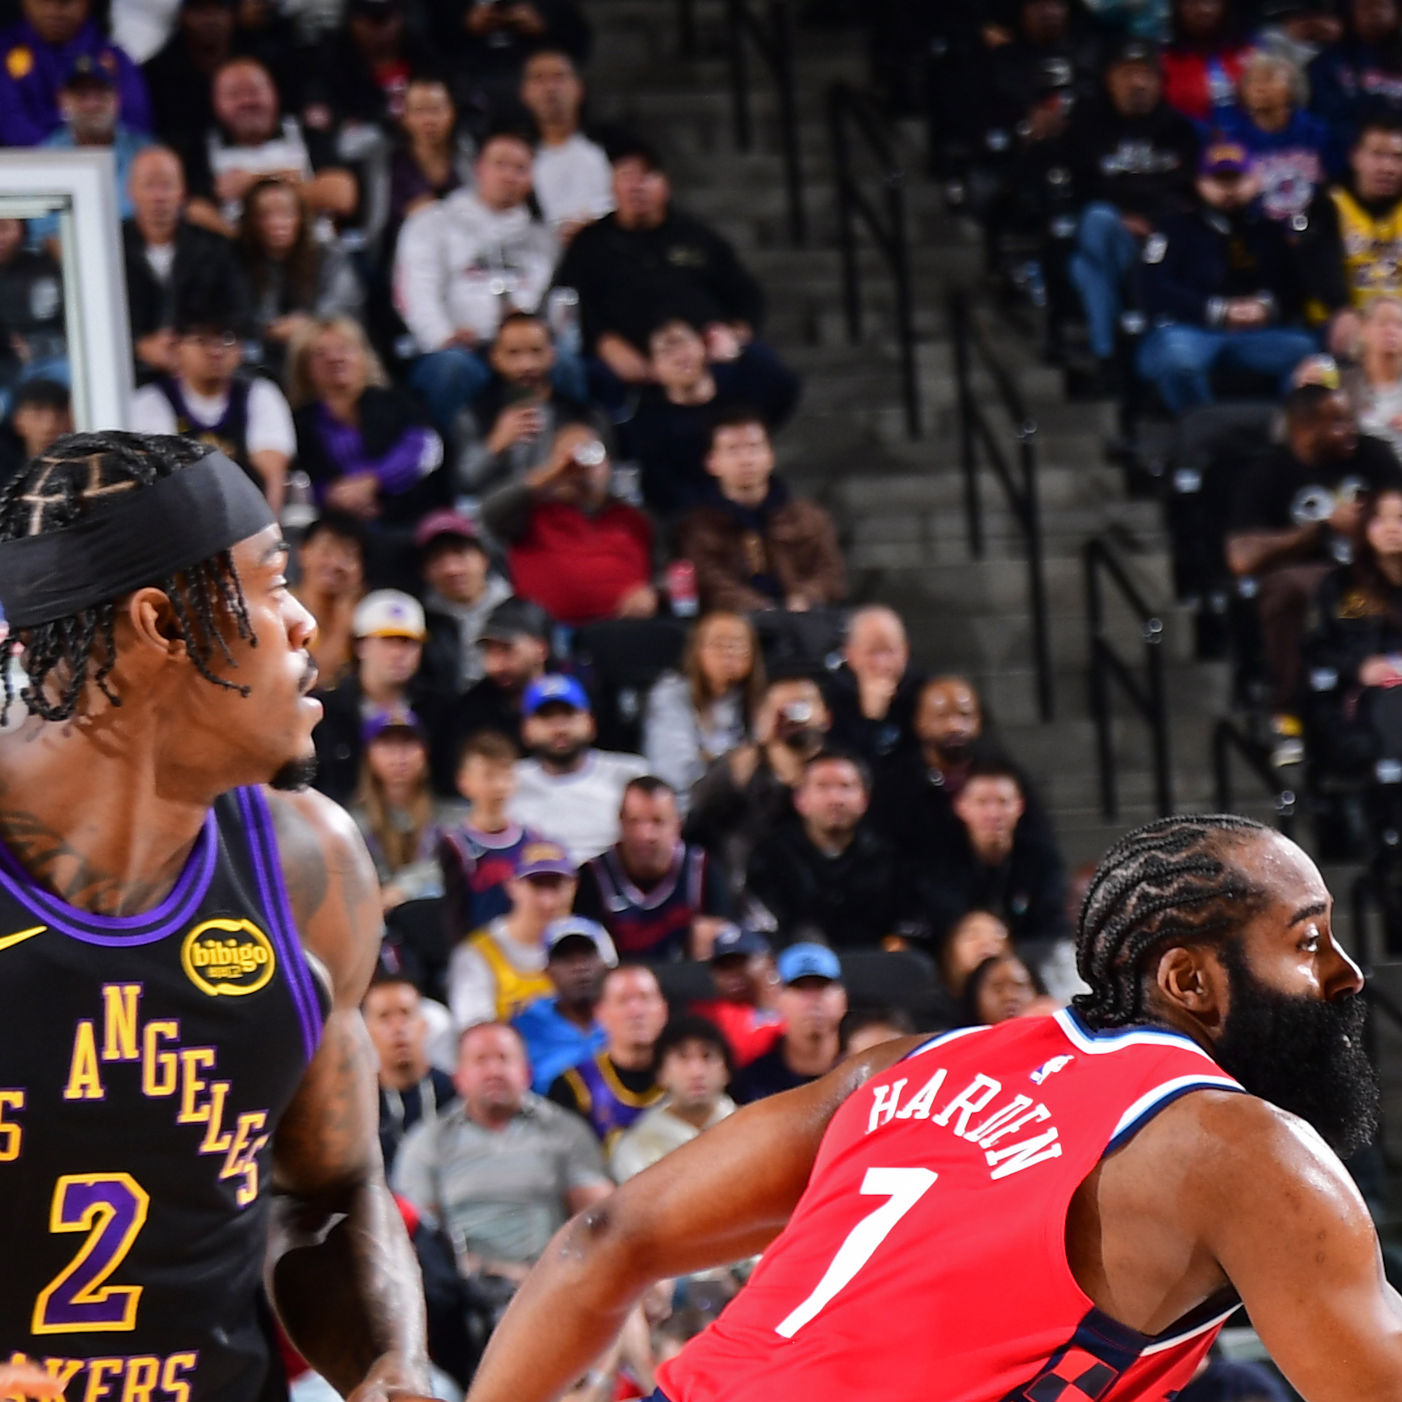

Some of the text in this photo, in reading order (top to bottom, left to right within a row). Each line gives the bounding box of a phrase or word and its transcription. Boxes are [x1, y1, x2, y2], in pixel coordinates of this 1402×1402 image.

[192, 938, 268, 973] bibigo
[62, 982, 270, 1207] ANGELES
[865, 1067, 1063, 1181] HARDEN
[31, 1172, 150, 1335] 2
[774, 1166, 939, 1339] 7
